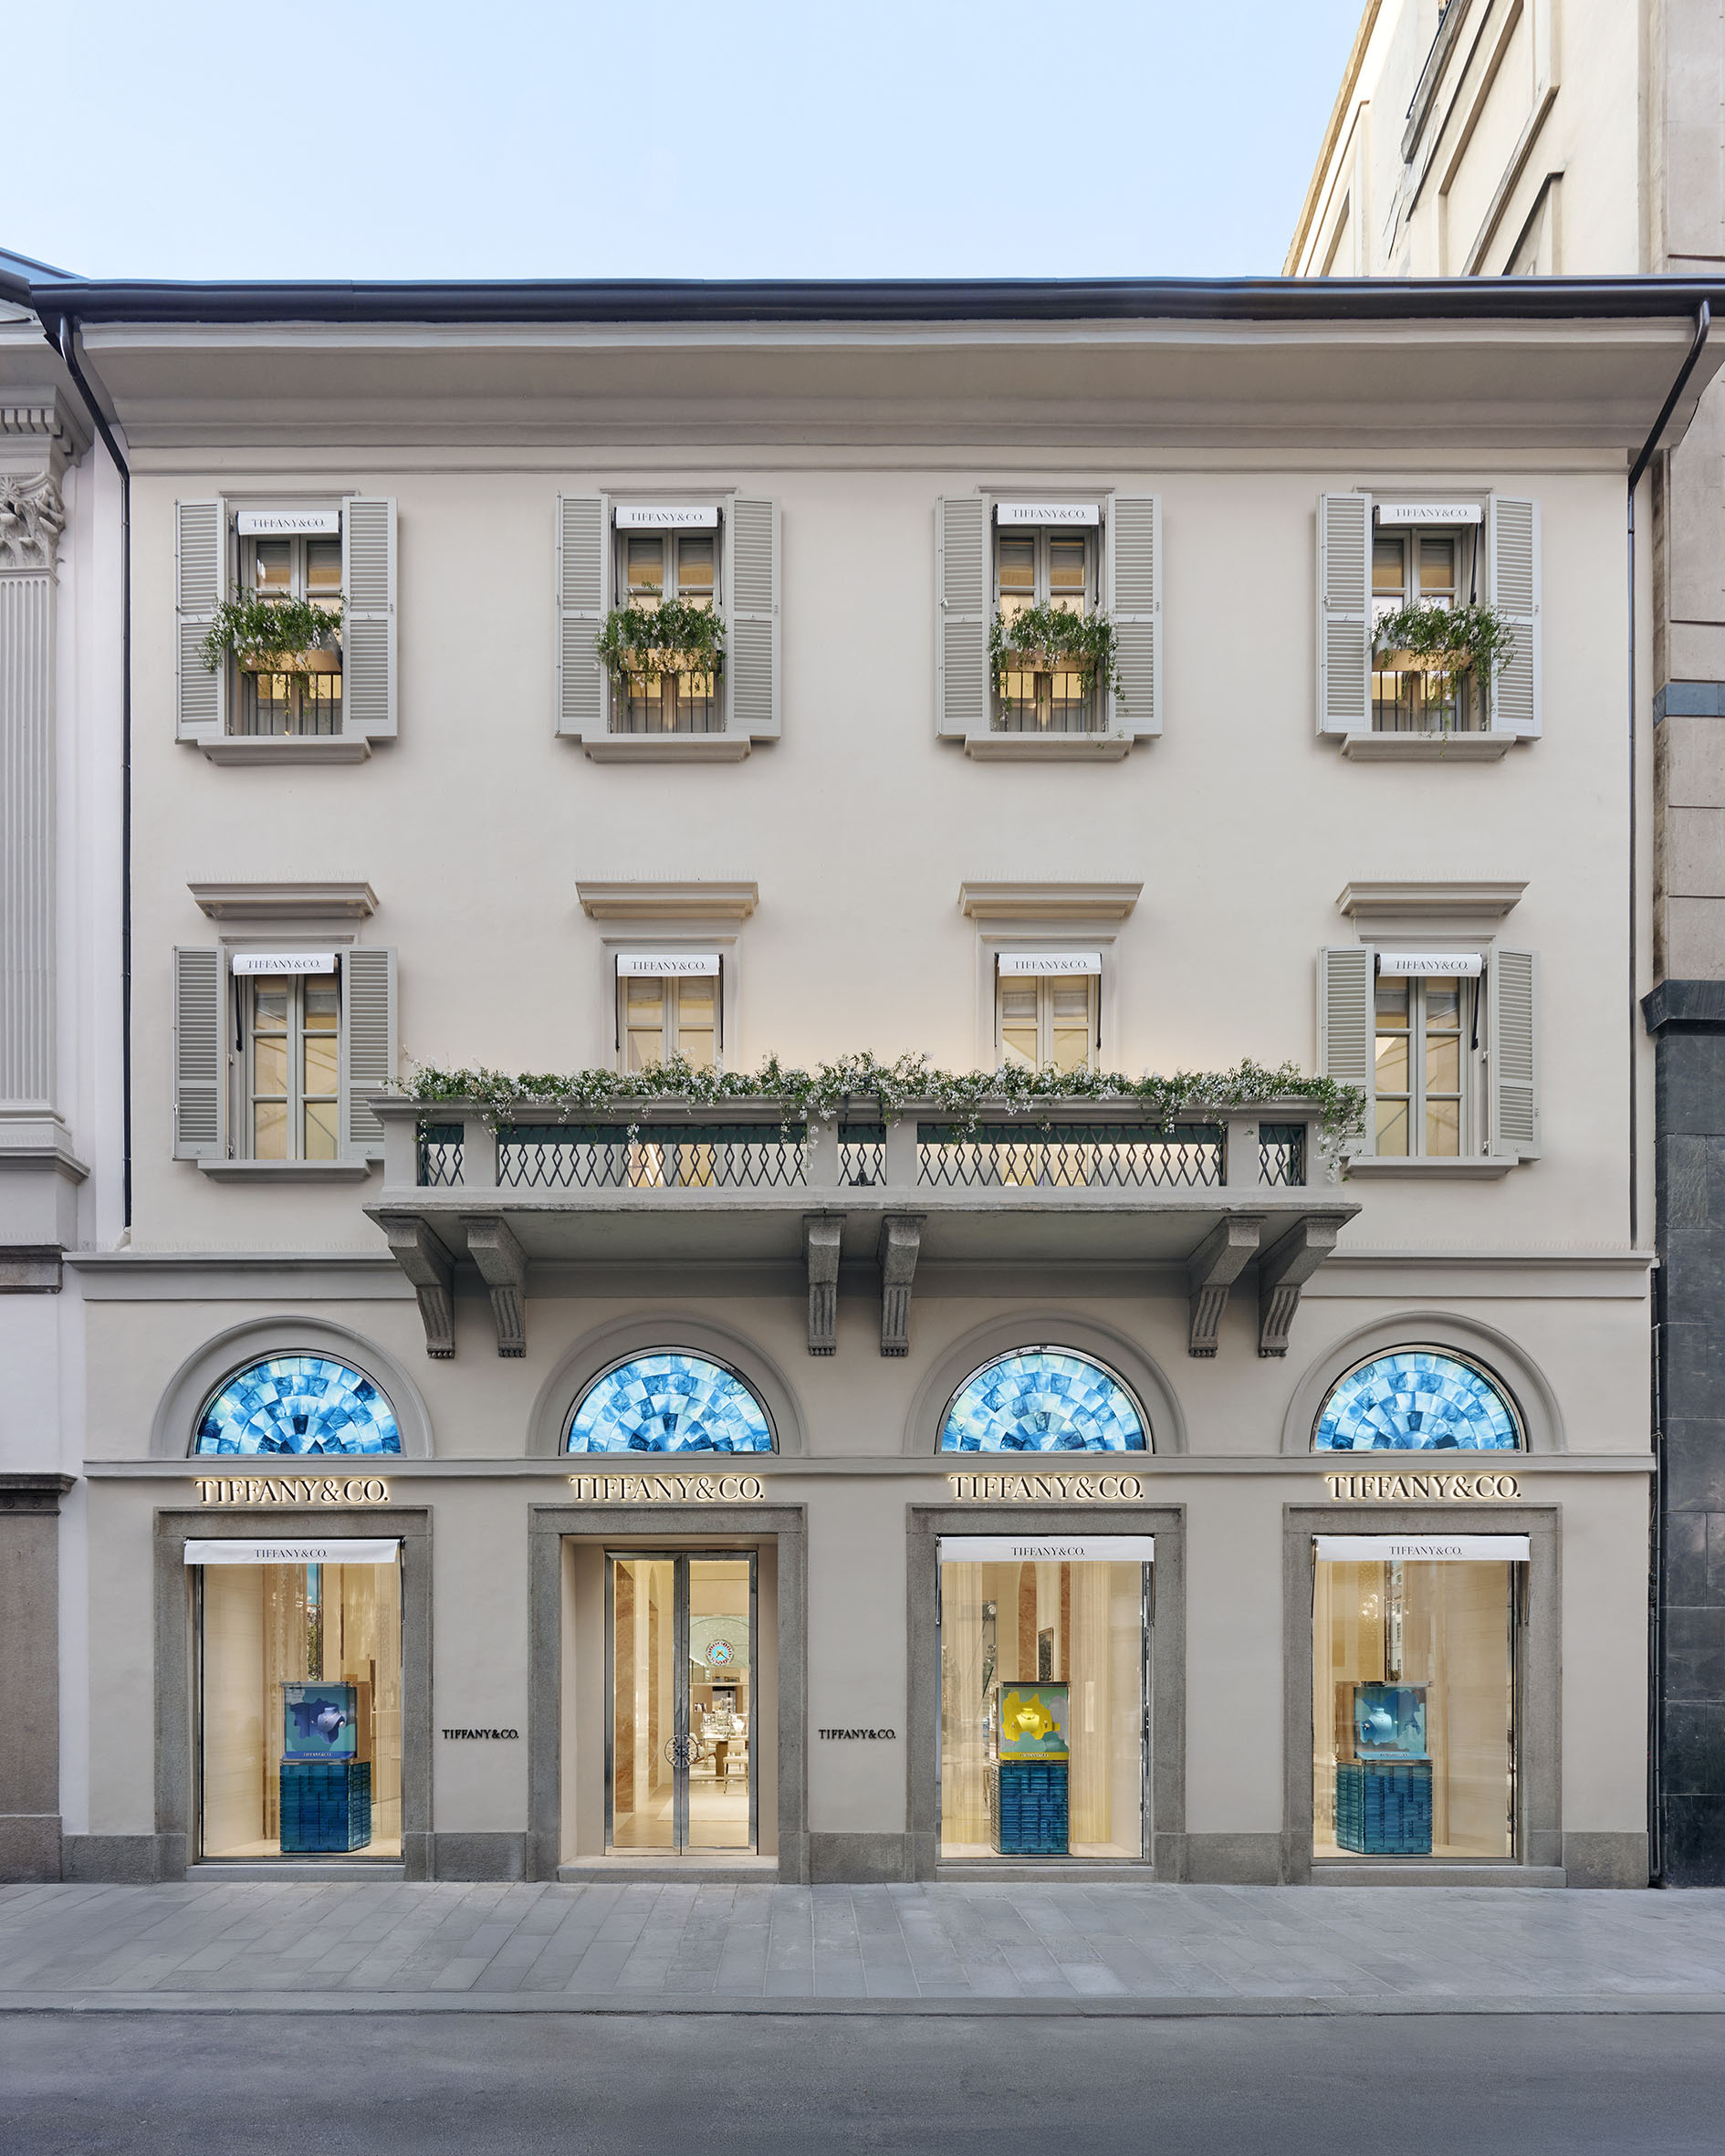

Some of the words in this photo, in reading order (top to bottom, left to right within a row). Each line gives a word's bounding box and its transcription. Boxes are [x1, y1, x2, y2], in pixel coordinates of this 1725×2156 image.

[194, 1480, 389, 1502] TIFFANY&CO.
[570, 1477, 764, 1500] TIFFANY&CO.
[950, 1476, 1144, 1499] TIFFANY&CO.
[1327, 1476, 1521, 1499] TIFFANY&CO.
[442, 1729, 519, 1739] TIFFANY&CO.
[818, 1729, 896, 1740] TIFFANY&CO.
